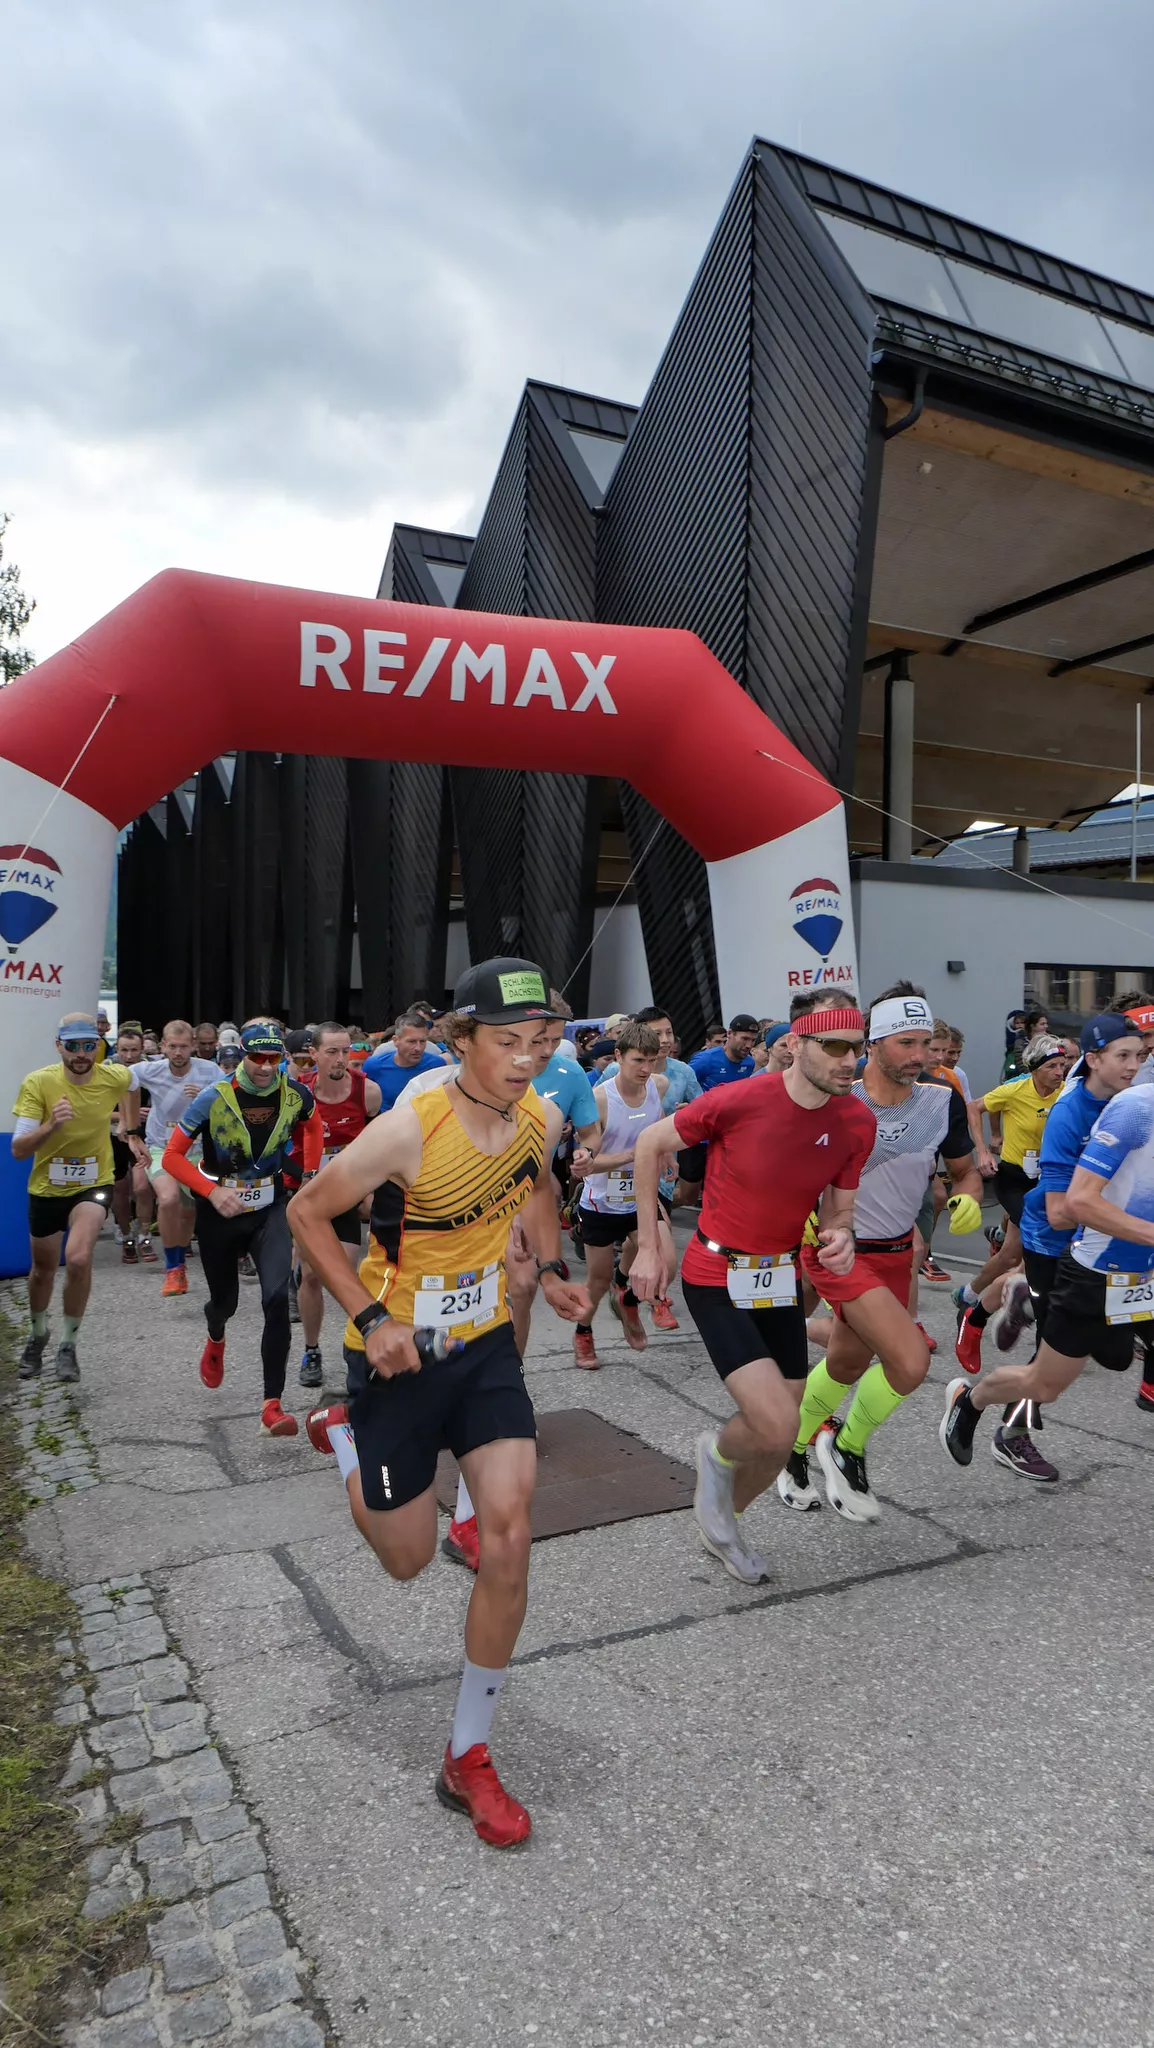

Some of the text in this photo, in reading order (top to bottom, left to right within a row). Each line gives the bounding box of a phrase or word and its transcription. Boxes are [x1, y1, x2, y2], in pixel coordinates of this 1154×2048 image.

[300, 621, 618, 715] RE/MAX
[796, 897, 840, 914] RE/MAX
[788, 965, 853, 987] RE/MAX
[62, 1166, 86, 1176] 172
[450, 1176, 516, 1228] LA SPO
[752, 1271, 773, 1288] 10
[440, 1285, 482, 1315] 234
[1122, 1284, 1154, 1304] 223
